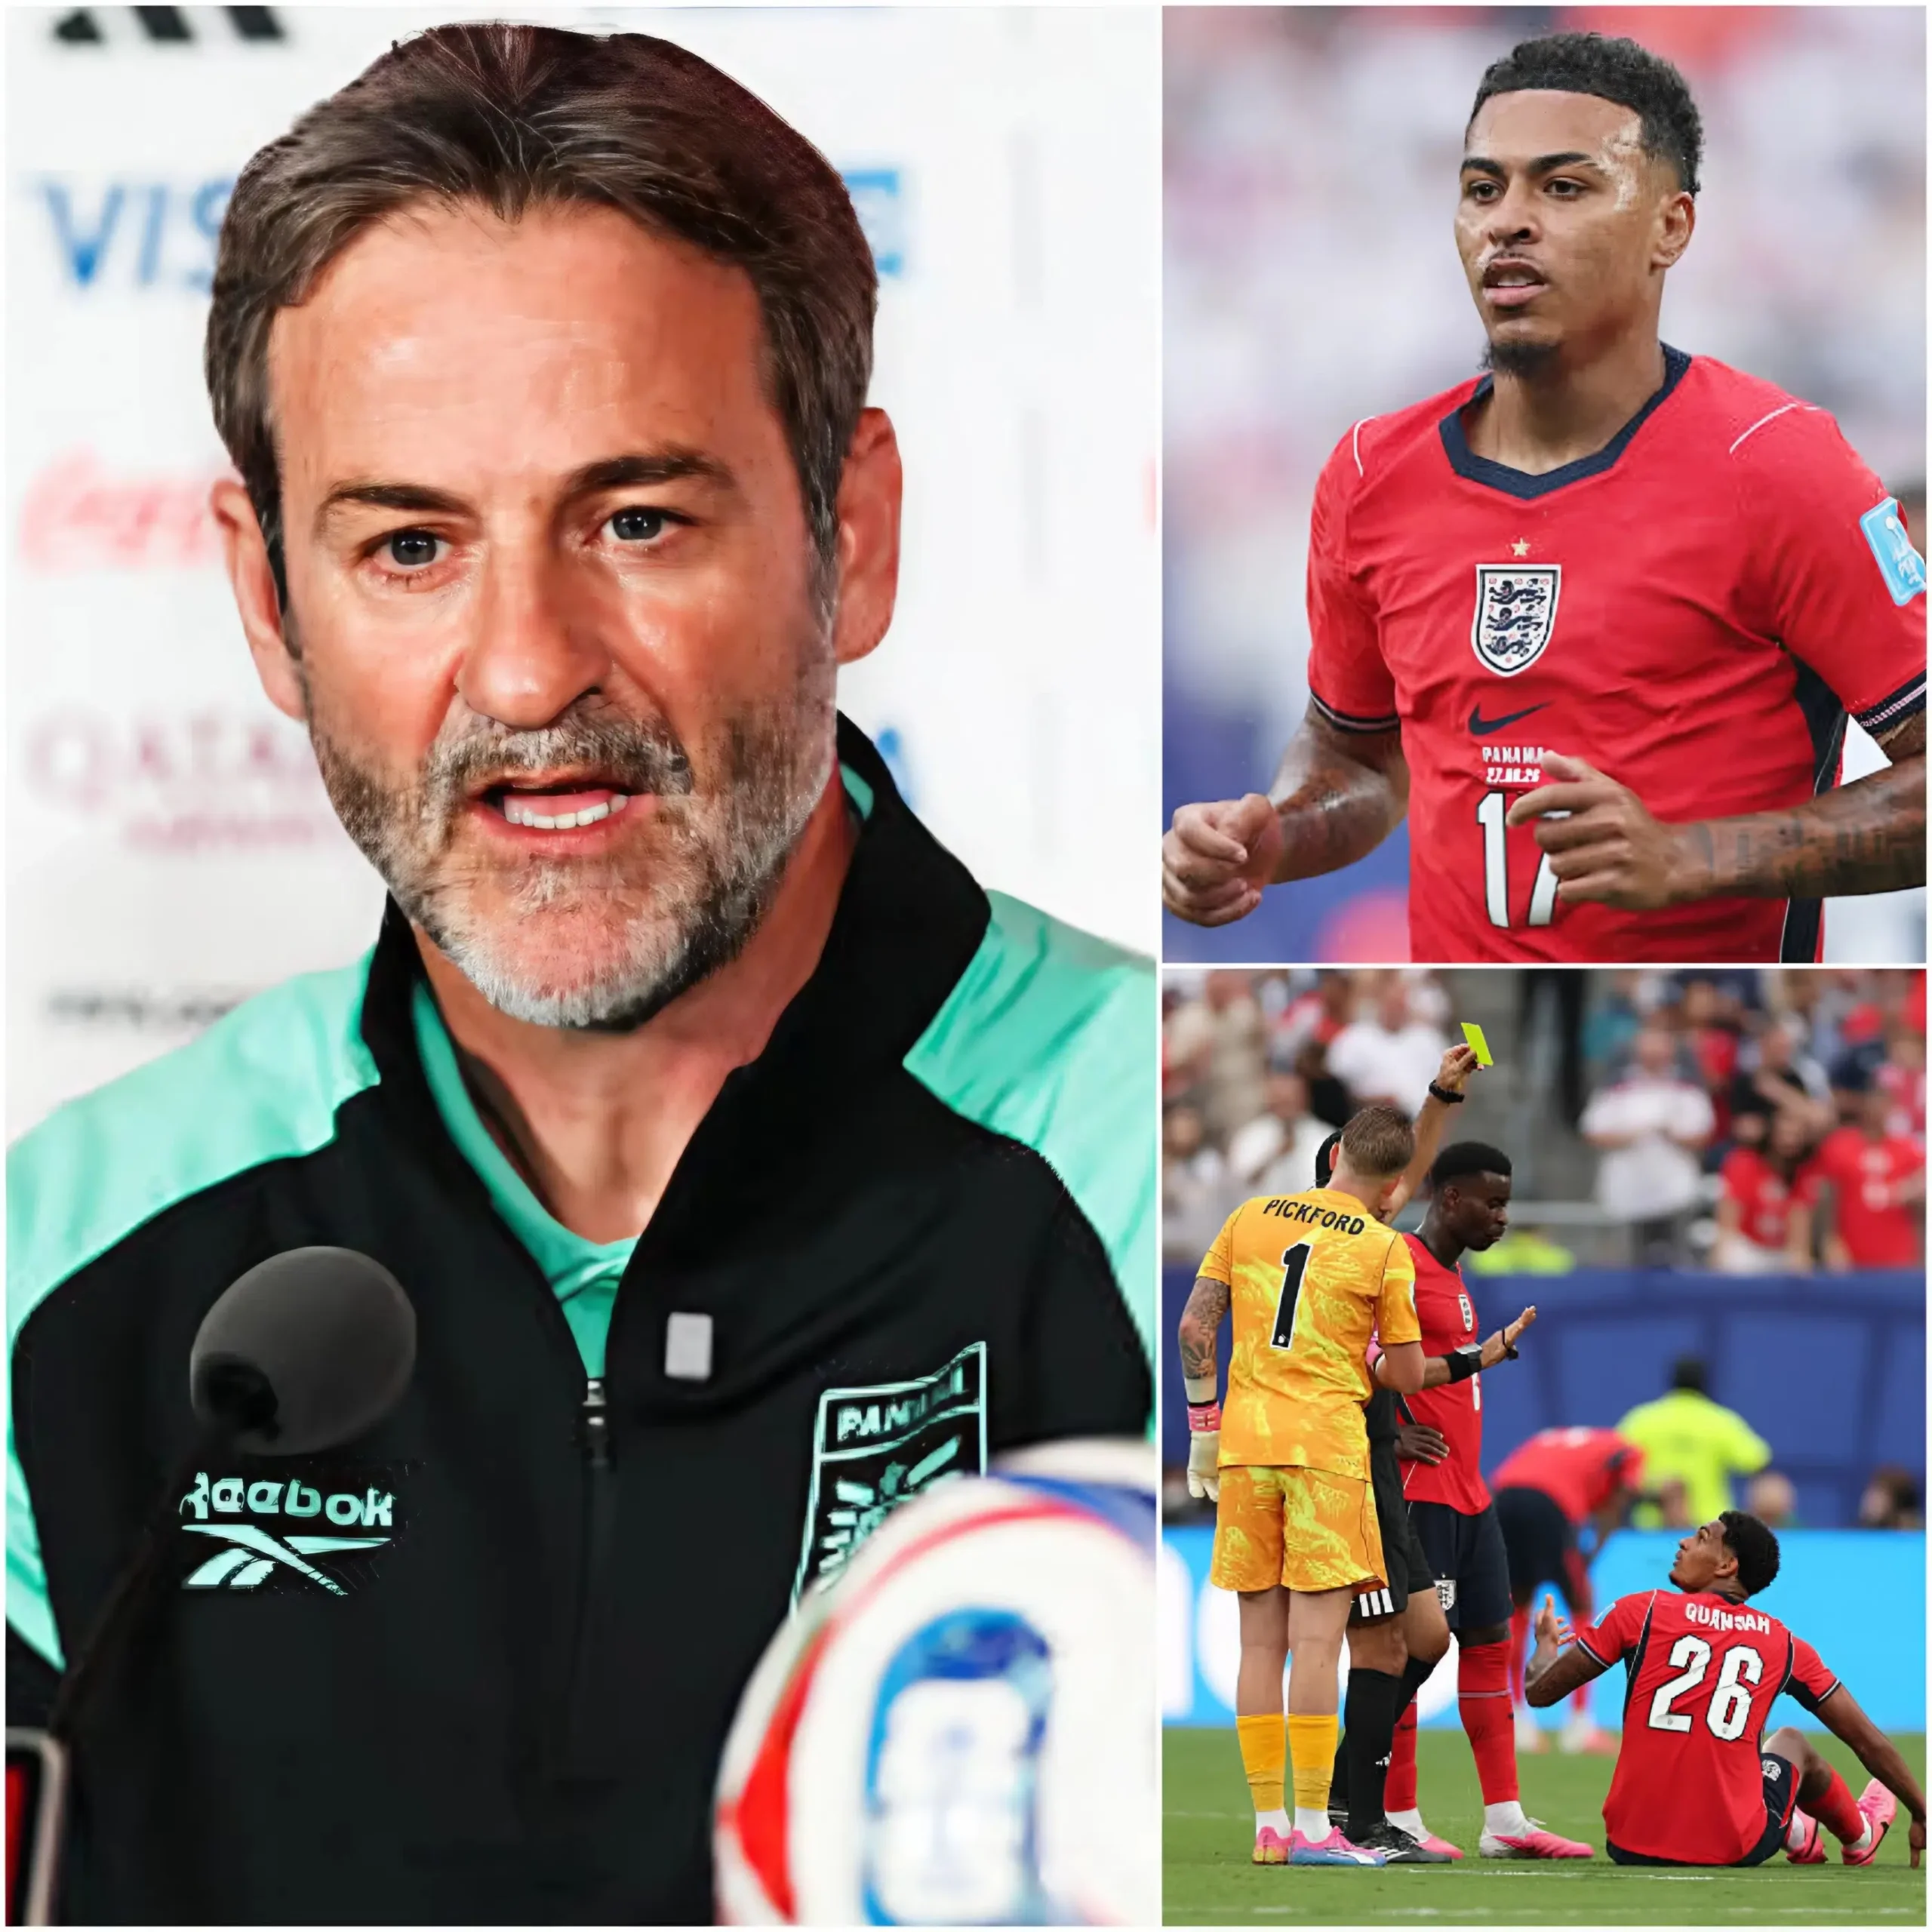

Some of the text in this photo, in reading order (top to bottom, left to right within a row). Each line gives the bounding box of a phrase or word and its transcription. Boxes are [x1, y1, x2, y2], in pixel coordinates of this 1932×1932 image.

[1263, 1198, 1365, 1236] PICKFORD
[1269, 1241, 1314, 1351] 1
[1684, 1602, 1770, 1635] QUANSAH
[1647, 1634, 1764, 1742] 26
